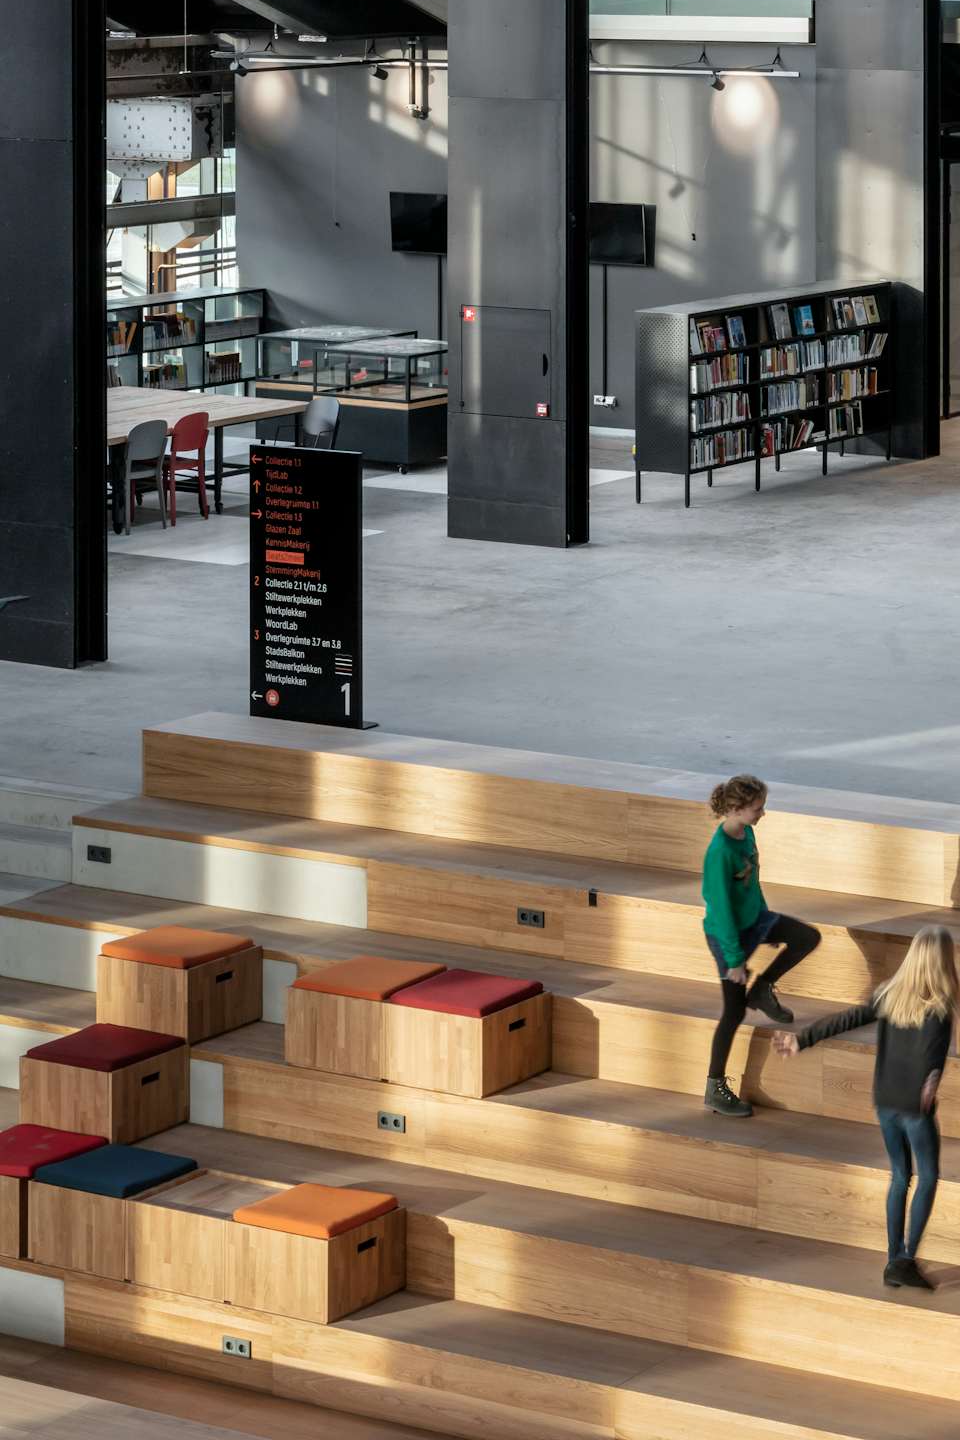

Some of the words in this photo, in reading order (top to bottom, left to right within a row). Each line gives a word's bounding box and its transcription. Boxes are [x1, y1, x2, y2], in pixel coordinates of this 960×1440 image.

[265, 456, 293, 467] Collectie
[265, 469, 288, 480] TijdLab
[265, 483, 293, 494] Collectie
[265, 497, 310, 509] Overlegruimte
[265, 510, 293, 521] Collectie
[265, 523, 287, 533] Glazen
[288, 525, 302, 535] Zaal
[265, 537, 310, 552] KennisMakerij
[265, 565, 320, 580] StemmingMakerij
[254, 575, 260, 586] 2
[265, 578, 293, 589] Collectie
[294, 580, 302, 590] 2.1
[303, 581, 316, 592] t/m
[317, 583, 327, 593] 2.6
[265, 591, 322, 606] Stiltewerkplekken
[265, 605, 307, 618] Werkplekken
[265, 619, 298, 630] WoordLab
[254, 629, 260, 640] 3
[265, 632, 311, 646] Overlegruimte
[312, 637, 321, 647] 3.7
[321, 640, 331, 648] en
[331, 639, 341, 650] 3.8
[265, 646, 305, 658] StadsBalkon
[265, 659, 322, 674] Stiltewerkplekken
[265, 672, 307, 686] Werkplekken
[341, 682, 351, 716] 1
